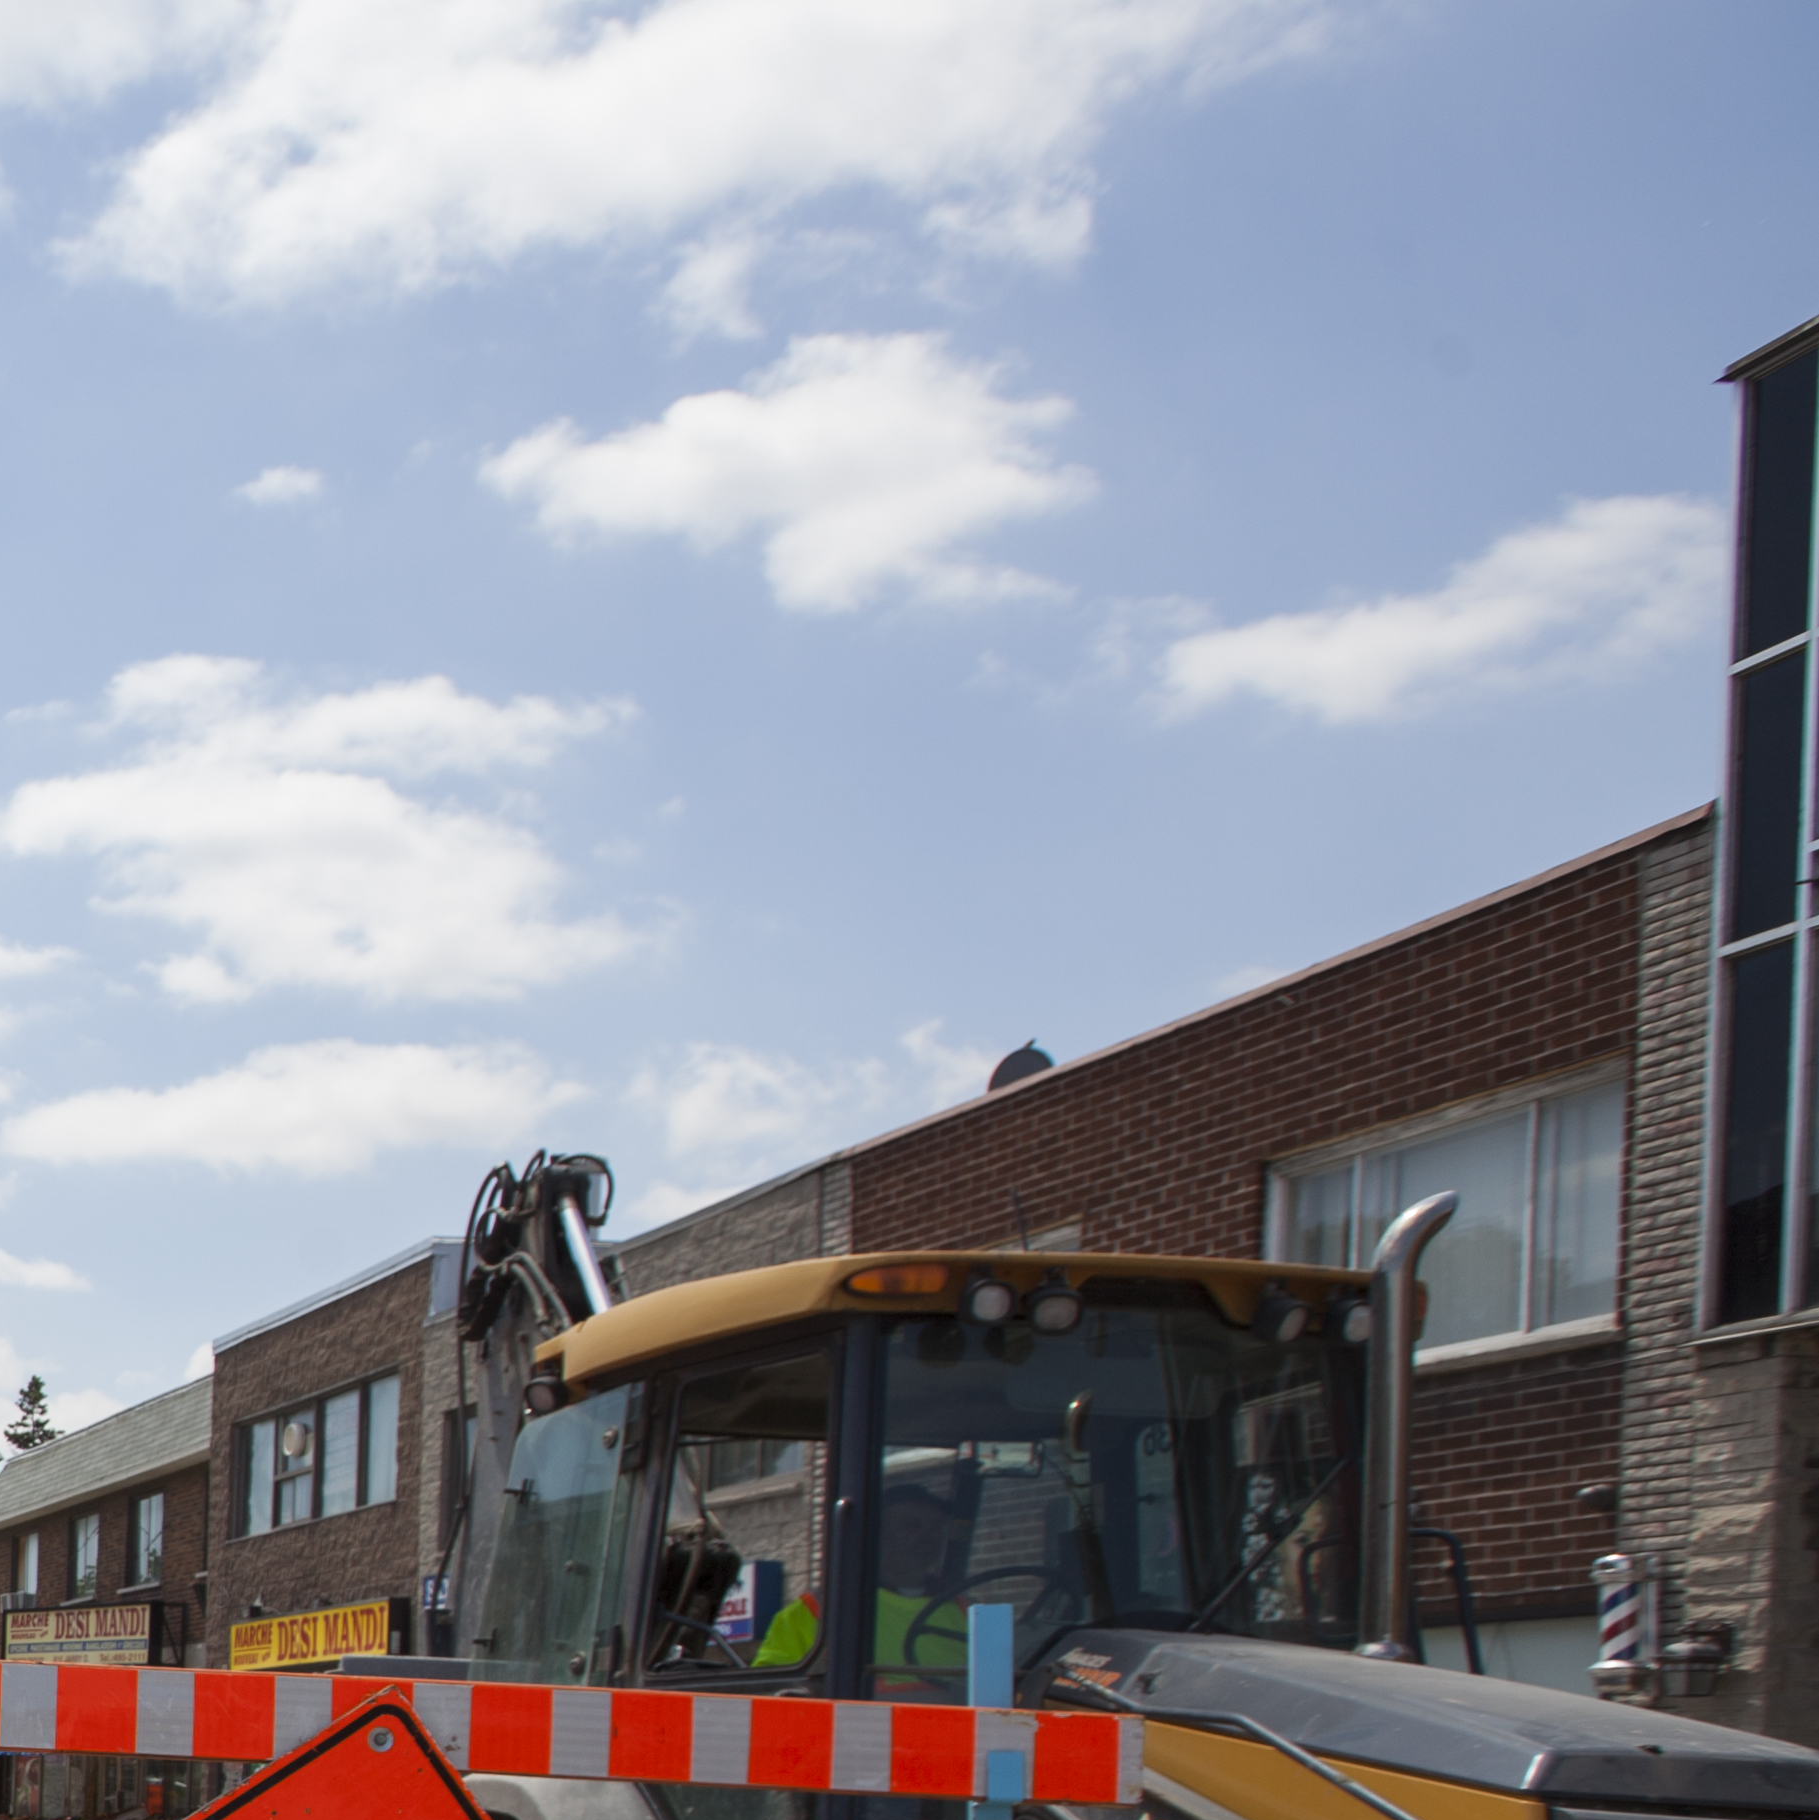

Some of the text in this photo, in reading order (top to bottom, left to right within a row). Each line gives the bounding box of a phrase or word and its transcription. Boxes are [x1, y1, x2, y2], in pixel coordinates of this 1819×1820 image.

[55, 1608, 90, 1640] DESI
[95, 1607, 146, 1638] MANDI
[277, 1615, 319, 1662] DESI
[323, 1606, 386, 1656] MANDI
